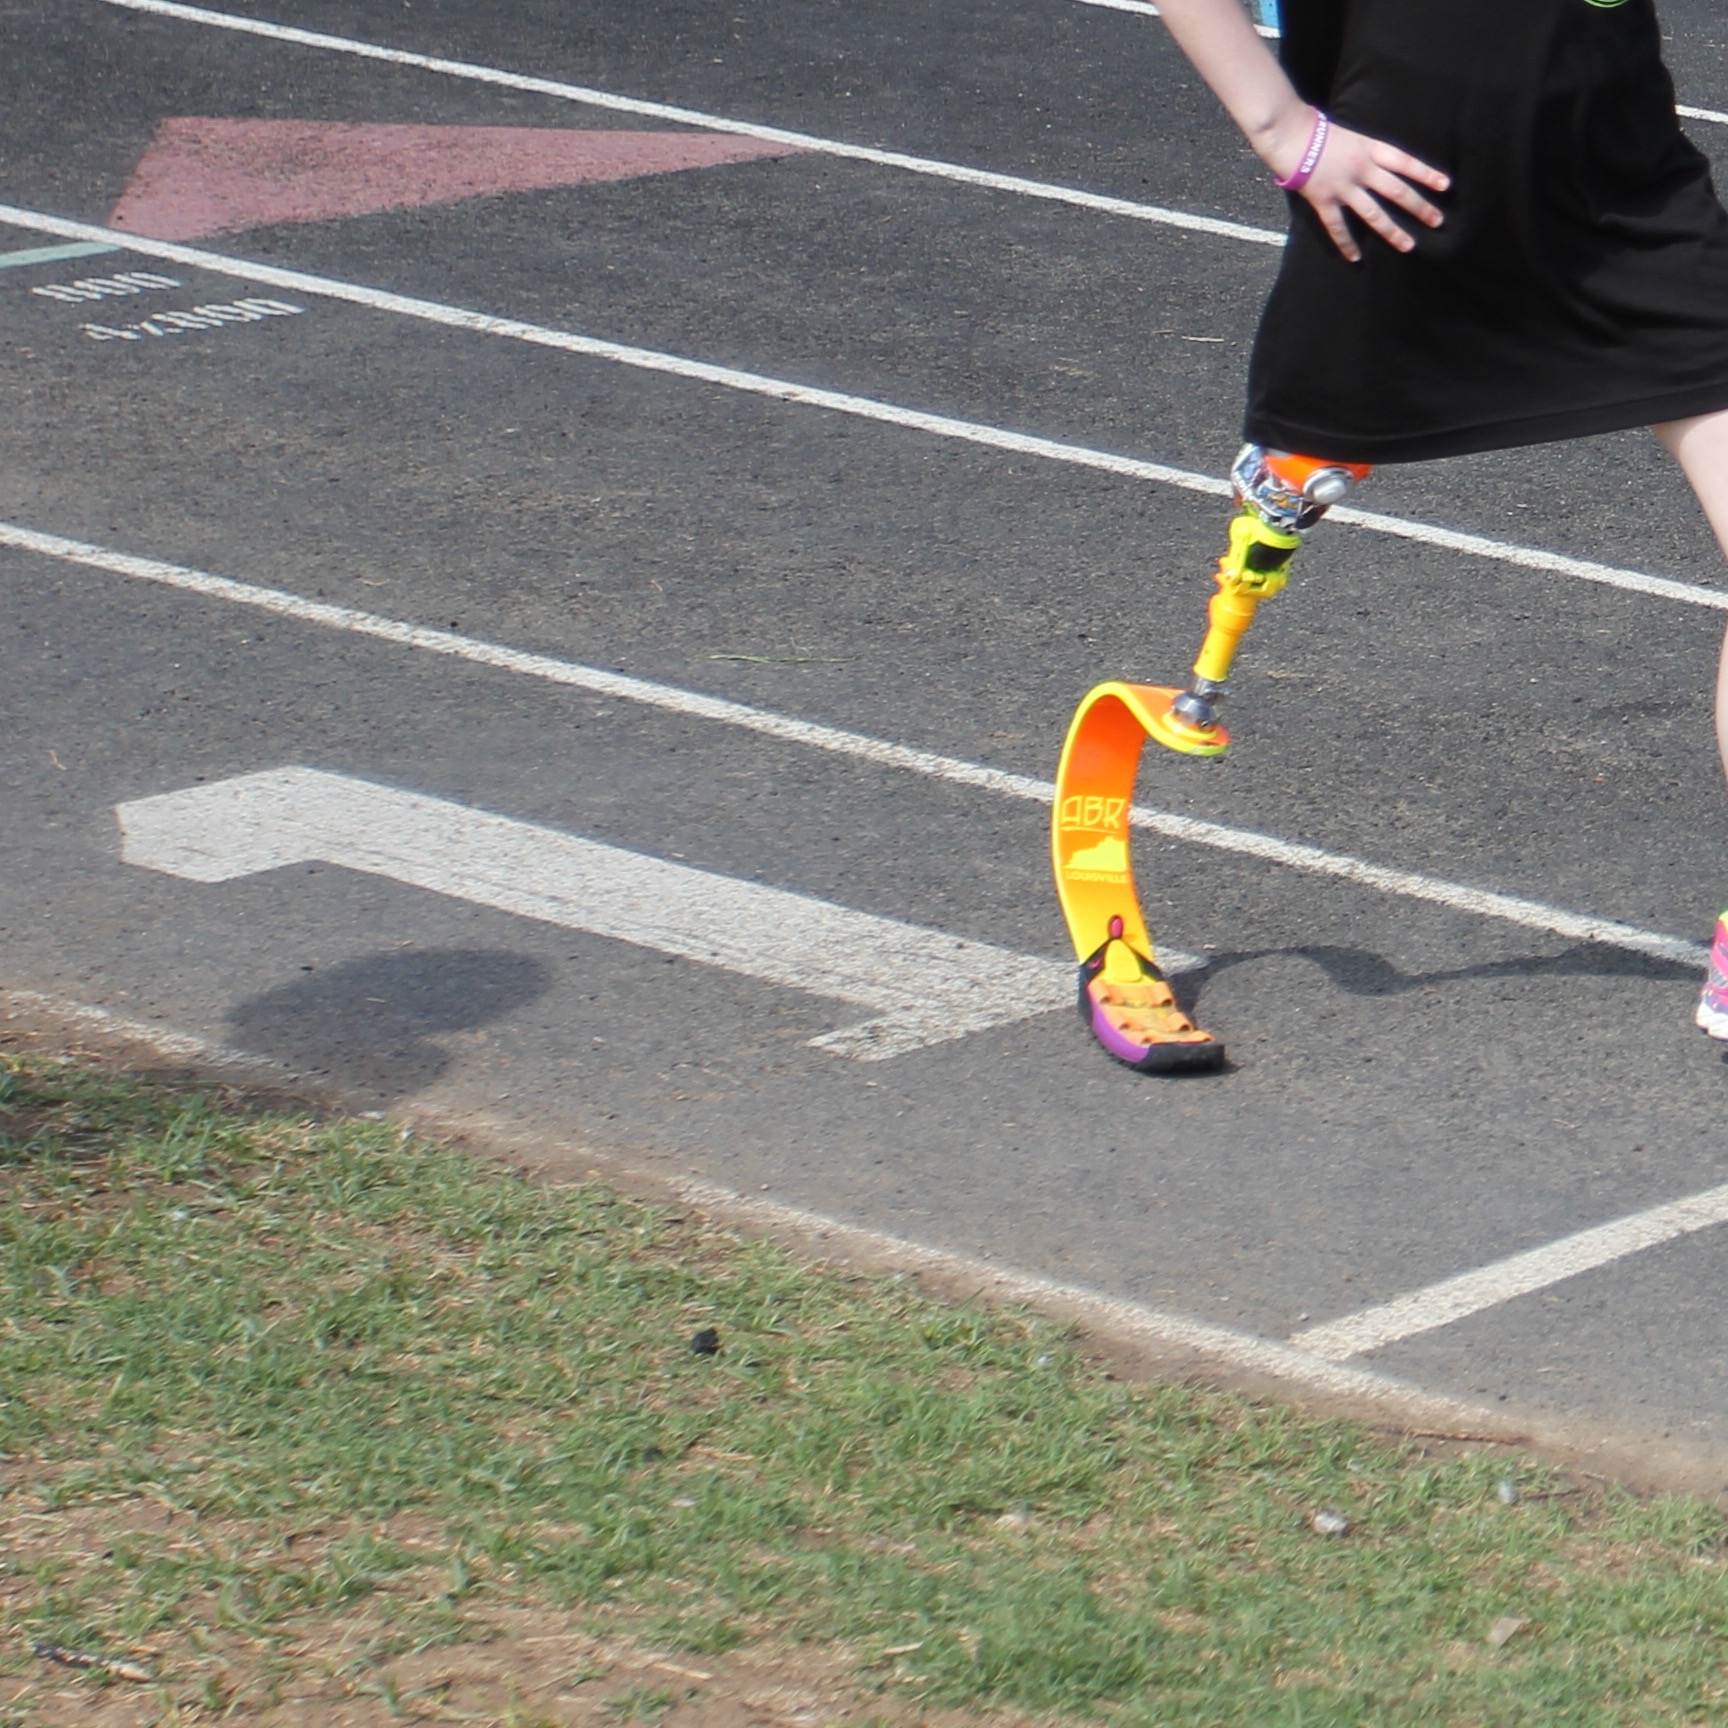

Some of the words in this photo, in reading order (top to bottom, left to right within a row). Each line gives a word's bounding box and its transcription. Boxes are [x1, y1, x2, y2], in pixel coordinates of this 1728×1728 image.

[1300, 120, 1328, 174] RUNNERS
[1060, 794, 1126, 829] ABR
[1065, 870, 1128, 885] LOUISVILLE
